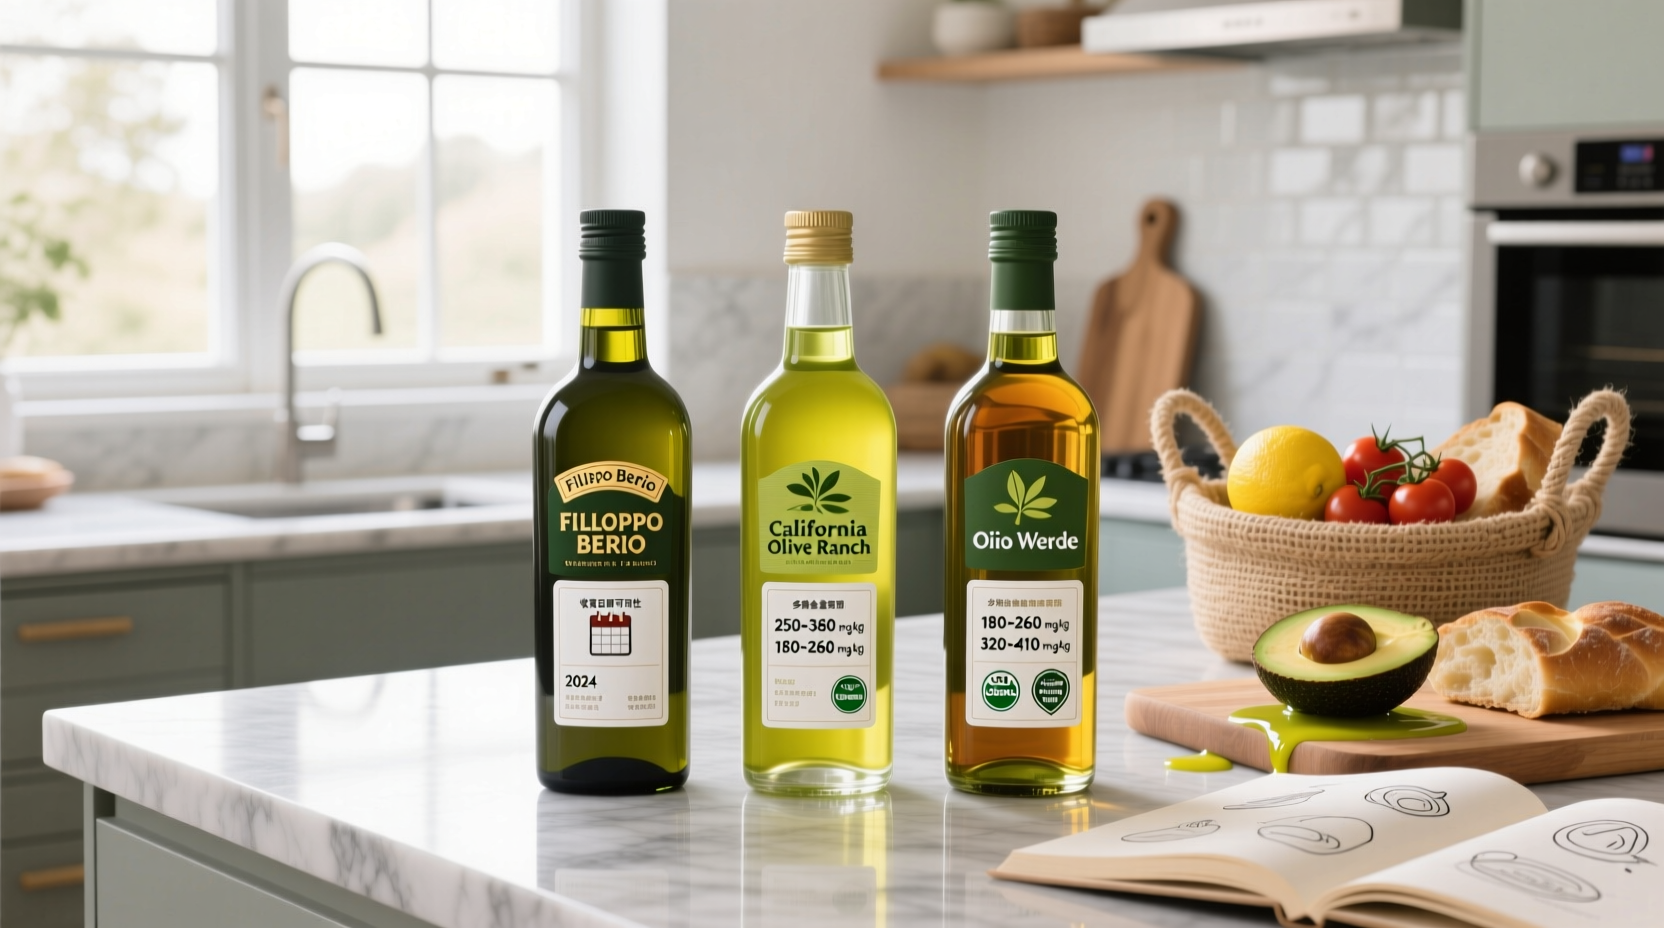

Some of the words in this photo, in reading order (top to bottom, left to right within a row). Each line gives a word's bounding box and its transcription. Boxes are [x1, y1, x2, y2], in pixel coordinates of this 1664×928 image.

[616, 469, 656, 492] Berio
[560, 512, 664, 532] FILLOPPO
[769, 519, 868, 538] California
[577, 534, 646, 555] BERIO
[767, 538, 812, 555] Olive
[817, 538, 871, 555] Ranch
[1016, 530, 1079, 550] Werde
[981, 615, 1042, 630] 180-260
[980, 637, 1040, 652] 320-410
[565, 674, 597, 689] 2024
